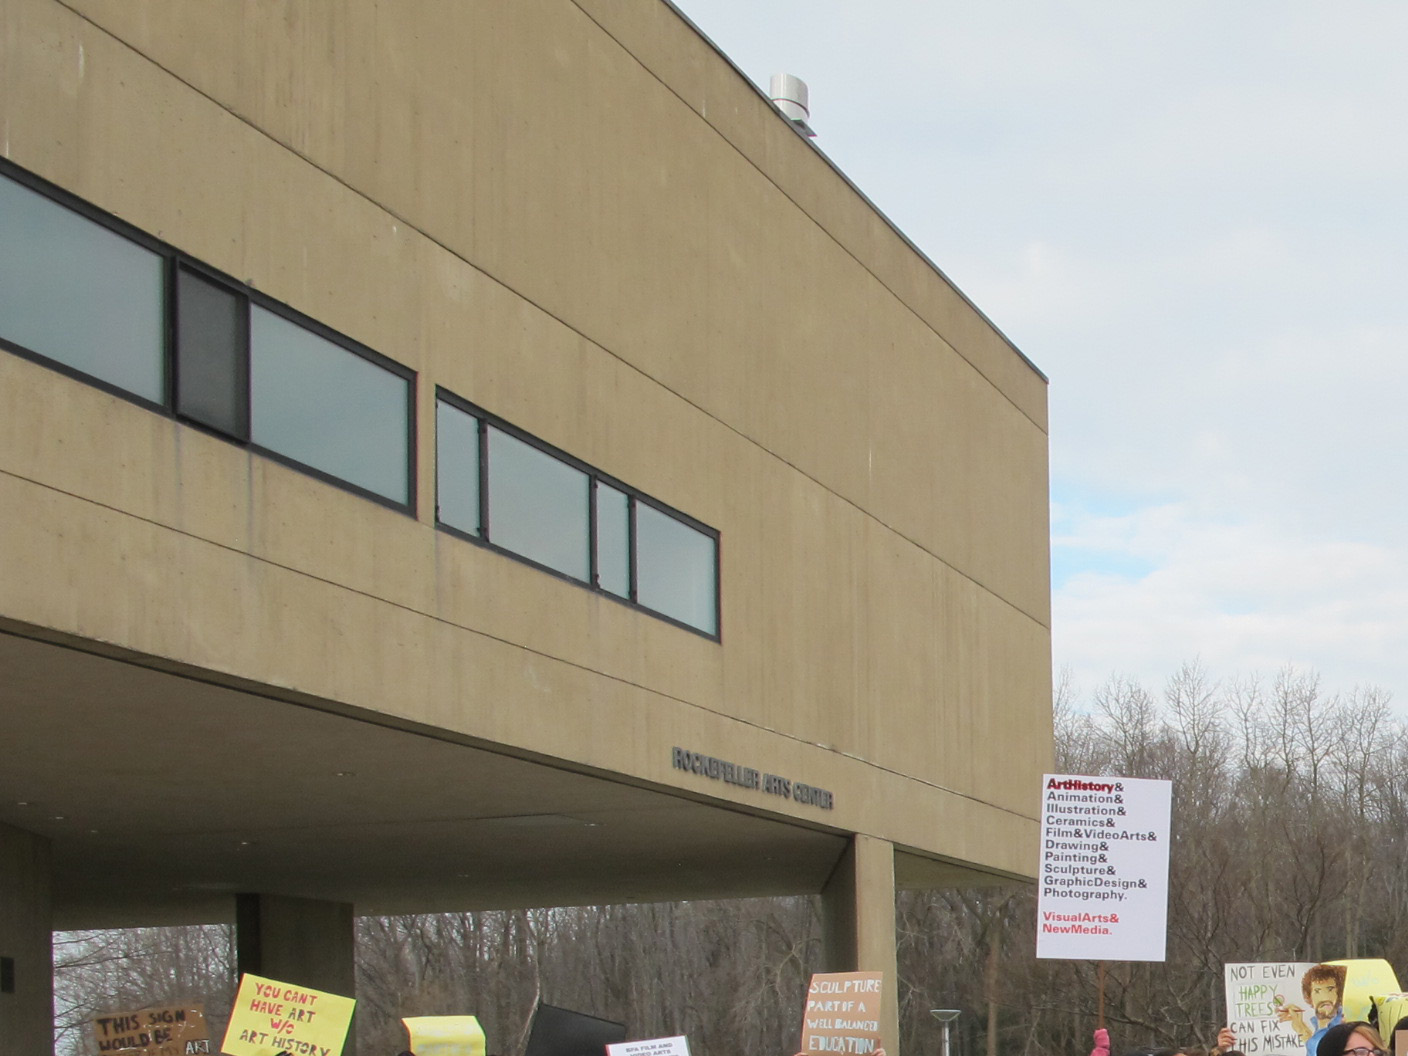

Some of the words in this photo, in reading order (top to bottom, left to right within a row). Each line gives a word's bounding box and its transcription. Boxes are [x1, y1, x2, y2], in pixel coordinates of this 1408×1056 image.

[672, 746, 761, 790] ROCKEFELLER
[762, 773, 792, 799] ARTS
[793, 782, 834, 810] CENTER
[1047, 778, 1124, 794] ArtHistory&
[1047, 791, 1124, 804] Animation&
[1046, 803, 1127, 816] Illustration&
[1046, 815, 1116, 828] Ceramics&
[1045, 827, 1158, 841] Film&VideoArts&
[1045, 839, 1109, 853] Drawing&
[1045, 851, 1108, 865] Painting&
[1044, 863, 1117, 876] Sculpture&
[1043, 876, 1148, 889] GraphicDesign&
[1043, 888, 1128, 901] Photography.
[1042, 911, 1119, 923] VisualArts&
[1042, 924, 1113, 935] NewMedia.
[1230, 965, 1256, 980] NOT
[1263, 965, 1295, 979] EVEN
[808, 979, 881, 993] SCULPTURE
[1239, 984, 1279, 1001] HAPPY
[255, 982, 281, 998] YOU
[283, 989, 318, 1006] CANT
[250, 999, 284, 1016] HAVE
[288, 1008, 316, 1023] ART
[807, 1000, 840, 1012] PART
[858, 1001, 866, 1012] A
[1235, 1002, 1273, 1018] TREES
[97, 1015, 140, 1036] THIS
[149, 1010, 186, 1024] SIGN
[270, 1018, 295, 1034] W/O
[806, 1018, 832, 1029] WELL
[834, 1018, 878, 1031] BALANCED
[1230, 1022, 1255, 1034] CAN
[1261, 1020, 1281, 1033] FIX
[99, 1033, 150, 1051] WOULD
[154, 1028, 173, 1044] BE
[240, 1029, 269, 1044] ART
[1263, 1034, 1305, 1052] MISTAKE
[185, 1040, 210, 1055] ART
[809, 1035, 875, 1054] EDUCATION
